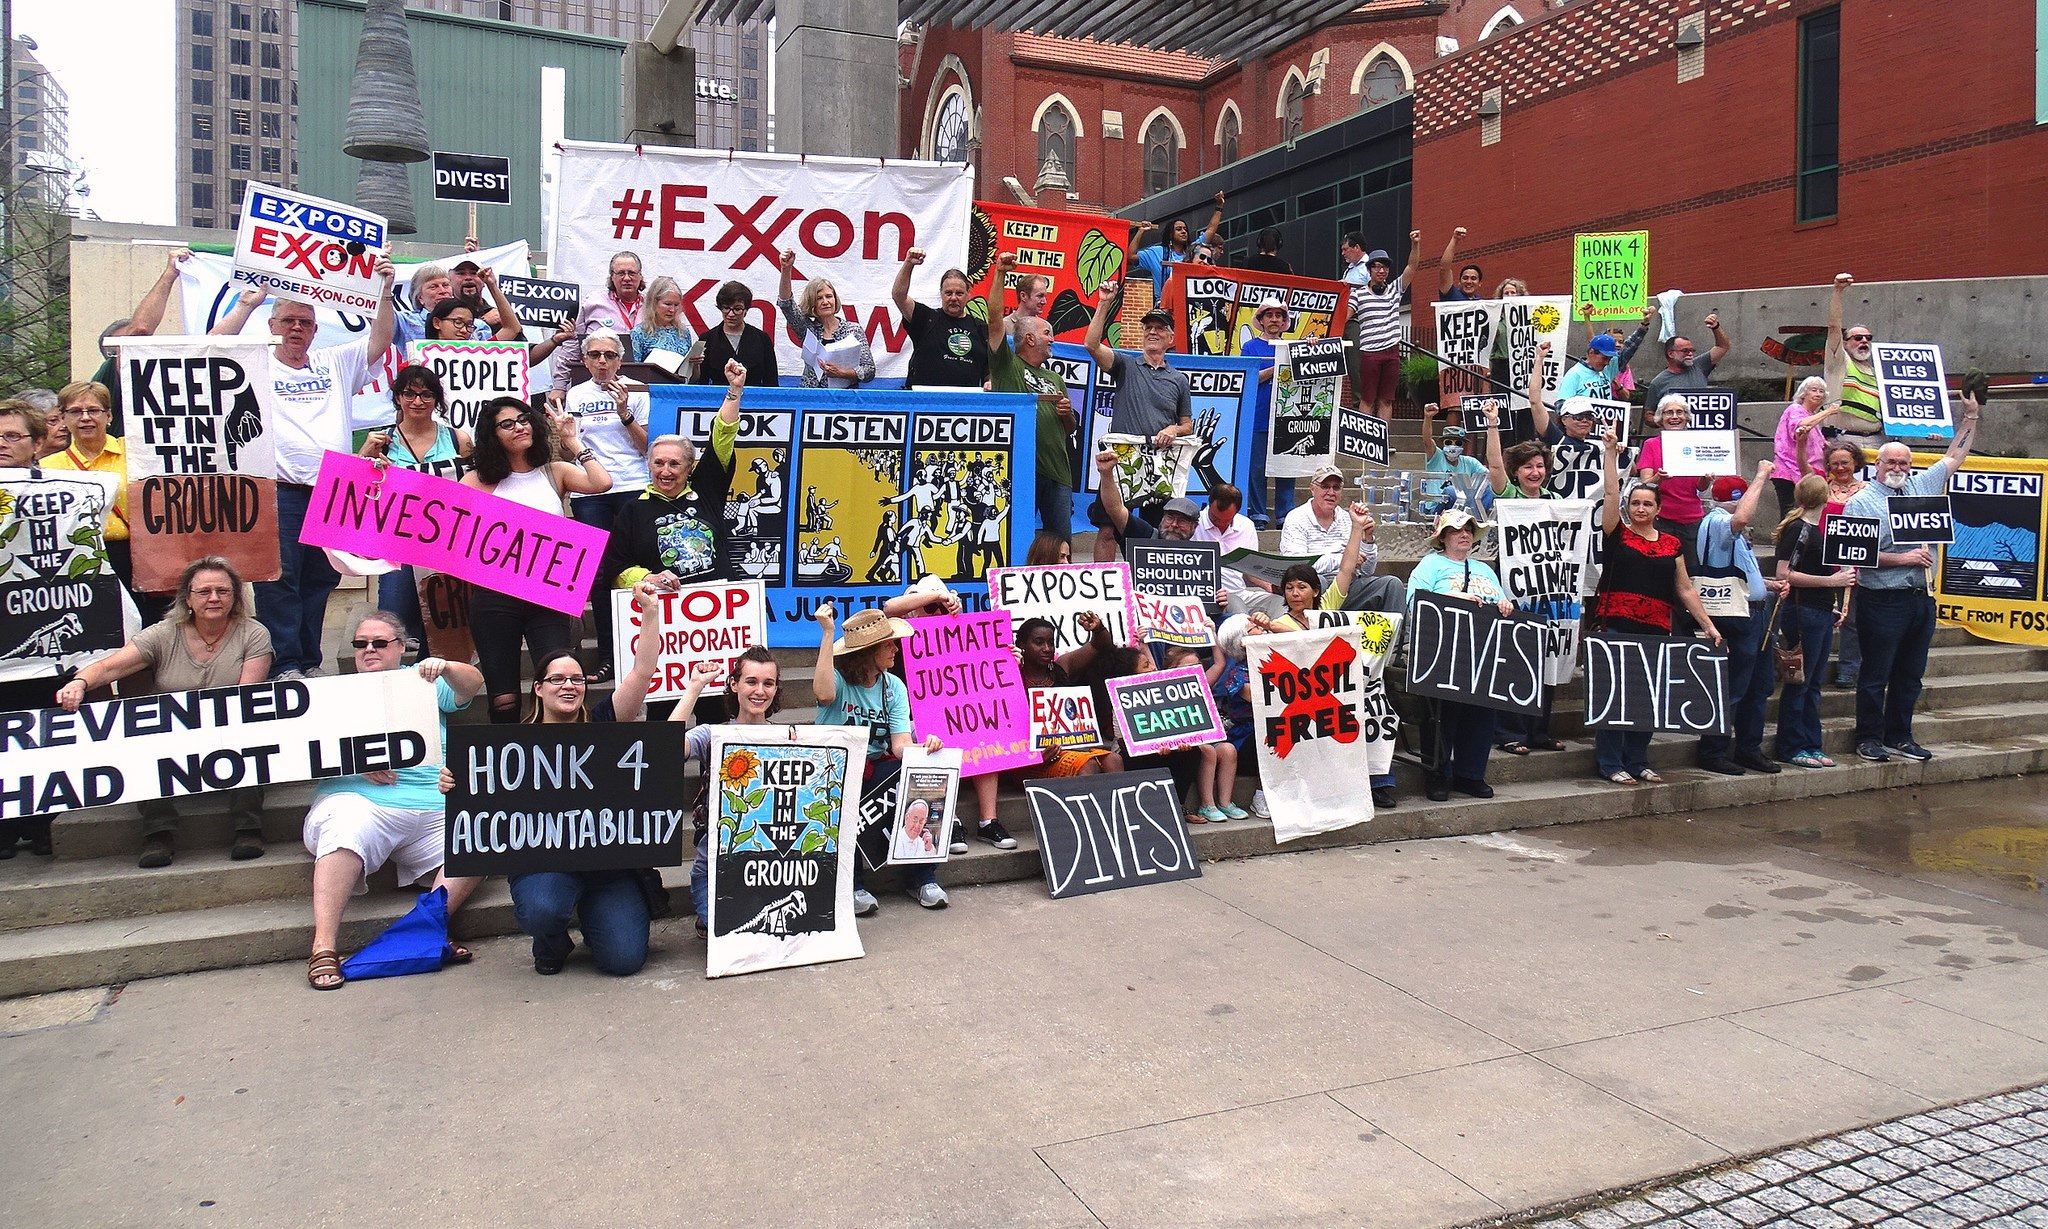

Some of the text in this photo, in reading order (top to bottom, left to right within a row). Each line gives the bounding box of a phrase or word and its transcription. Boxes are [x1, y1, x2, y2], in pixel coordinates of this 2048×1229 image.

[696, 78, 737, 99] tte.
[436, 168, 508, 190] DIVEST
[612, 183, 915, 280] #Exxon
[1006, 221, 1054, 240] KEEP IT
[1582, 237, 1640, 257] HONK 4
[1019, 250, 1063, 267] IN THE
[1584, 260, 1634, 279] GREEN
[1193, 280, 1234, 297] LOOK
[1580, 282, 1639, 301] ENERGY
[1290, 292, 1336, 310] DECIDE
[1578, 304, 1643, 316] cdepink.or
[1440, 309, 1488, 341] KEEP
[1509, 305, 1532, 328] OIL
[1444, 338, 1474, 353] IT IN
[1511, 326, 1538, 349] COAL
[1448, 351, 1475, 364] THE
[1512, 347, 1535, 361] GAS
[1880, 349, 1934, 363] EXXON
[433, 358, 519, 391] PEOPLE
[1042, 359, 1079, 381] OK
[1300, 361, 1338, 376] KNEW
[1513, 361, 1559, 378] CLITE
[1892, 365, 1928, 378] LIES
[130, 357, 246, 416] KEEP
[1513, 376, 1557, 391] CHS
[1890, 386, 1936, 401] SEAS
[1463, 397, 1507, 411] #EXON
[1593, 403, 1624, 422] XXON
[1687, 395, 1730, 411] REED
[1896, 403, 1936, 418] RISE
[143, 417, 217, 444] IT IN
[692, 412, 778, 438] LOK
[807, 415, 902, 441] LISTEN
[918, 417, 1011, 443] DECIDE
[1288, 420, 1320, 433] GROUND
[1340, 413, 1387, 440] ARREST
[1476, 415, 1500, 428] LID
[1687, 413, 1725, 429] ILLS
[1344, 435, 1384, 461] EXXON
[155, 446, 217, 473] THE
[1553, 446, 1632, 474] STA
[1551, 471, 1600, 498] UP
[1952, 474, 2037, 493] LISTEN
[15, 492, 75, 518] KEEP
[142, 477, 259, 535] GROUND
[34, 521, 51, 535] IT
[1891, 513, 1951, 529] DIVEST
[36, 537, 53, 551] IN
[322, 477, 587, 592] INVESTIGATE!
[1505, 520, 1582, 556] PROTECT
[30, 552, 62, 569] THE
[1147, 552, 1203, 566] ENERGY
[1532, 551, 1562, 564] OUR
[1838, 543, 1867, 561] LIED
[1136, 567, 1213, 581] SHOULDN'T
[1001, 570, 1122, 605] EXPOSE
[1136, 583, 1214, 597] COST LIVES
[6, 583, 93, 615] GROUND
[1936, 604, 1964, 621] EE
[1967, 609, 2004, 624] FROM
[909, 619, 1009, 660] CLIMATE
[1412, 600, 1547, 707] DIVEST
[647, 657, 740, 694] GRE
[913, 660, 1014, 700] JUSTICE
[1261, 660, 1356, 706] FOSSIL
[1584, 637, 1728, 733] DIVEST
[1119, 681, 1204, 710] SAVE OUR
[0, 679, 310, 752] REVENTED
[944, 698, 1012, 736] NOW!
[1133, 704, 1204, 735] EARTH
[1265, 704, 1358, 748] FREE
[0, 730, 426, 818] HAD NOT LIED
[467, 739, 649, 795] HONK 4
[763, 759, 815, 786] KEEP
[778, 792, 794, 807] IT
[777, 811, 792, 826] IN
[452, 808, 683, 854] ACCOUNTABILITY
[769, 825, 798, 841] THE
[1025, 779, 1194, 897] DIVEST
[743, 860, 819, 888] GROUND
